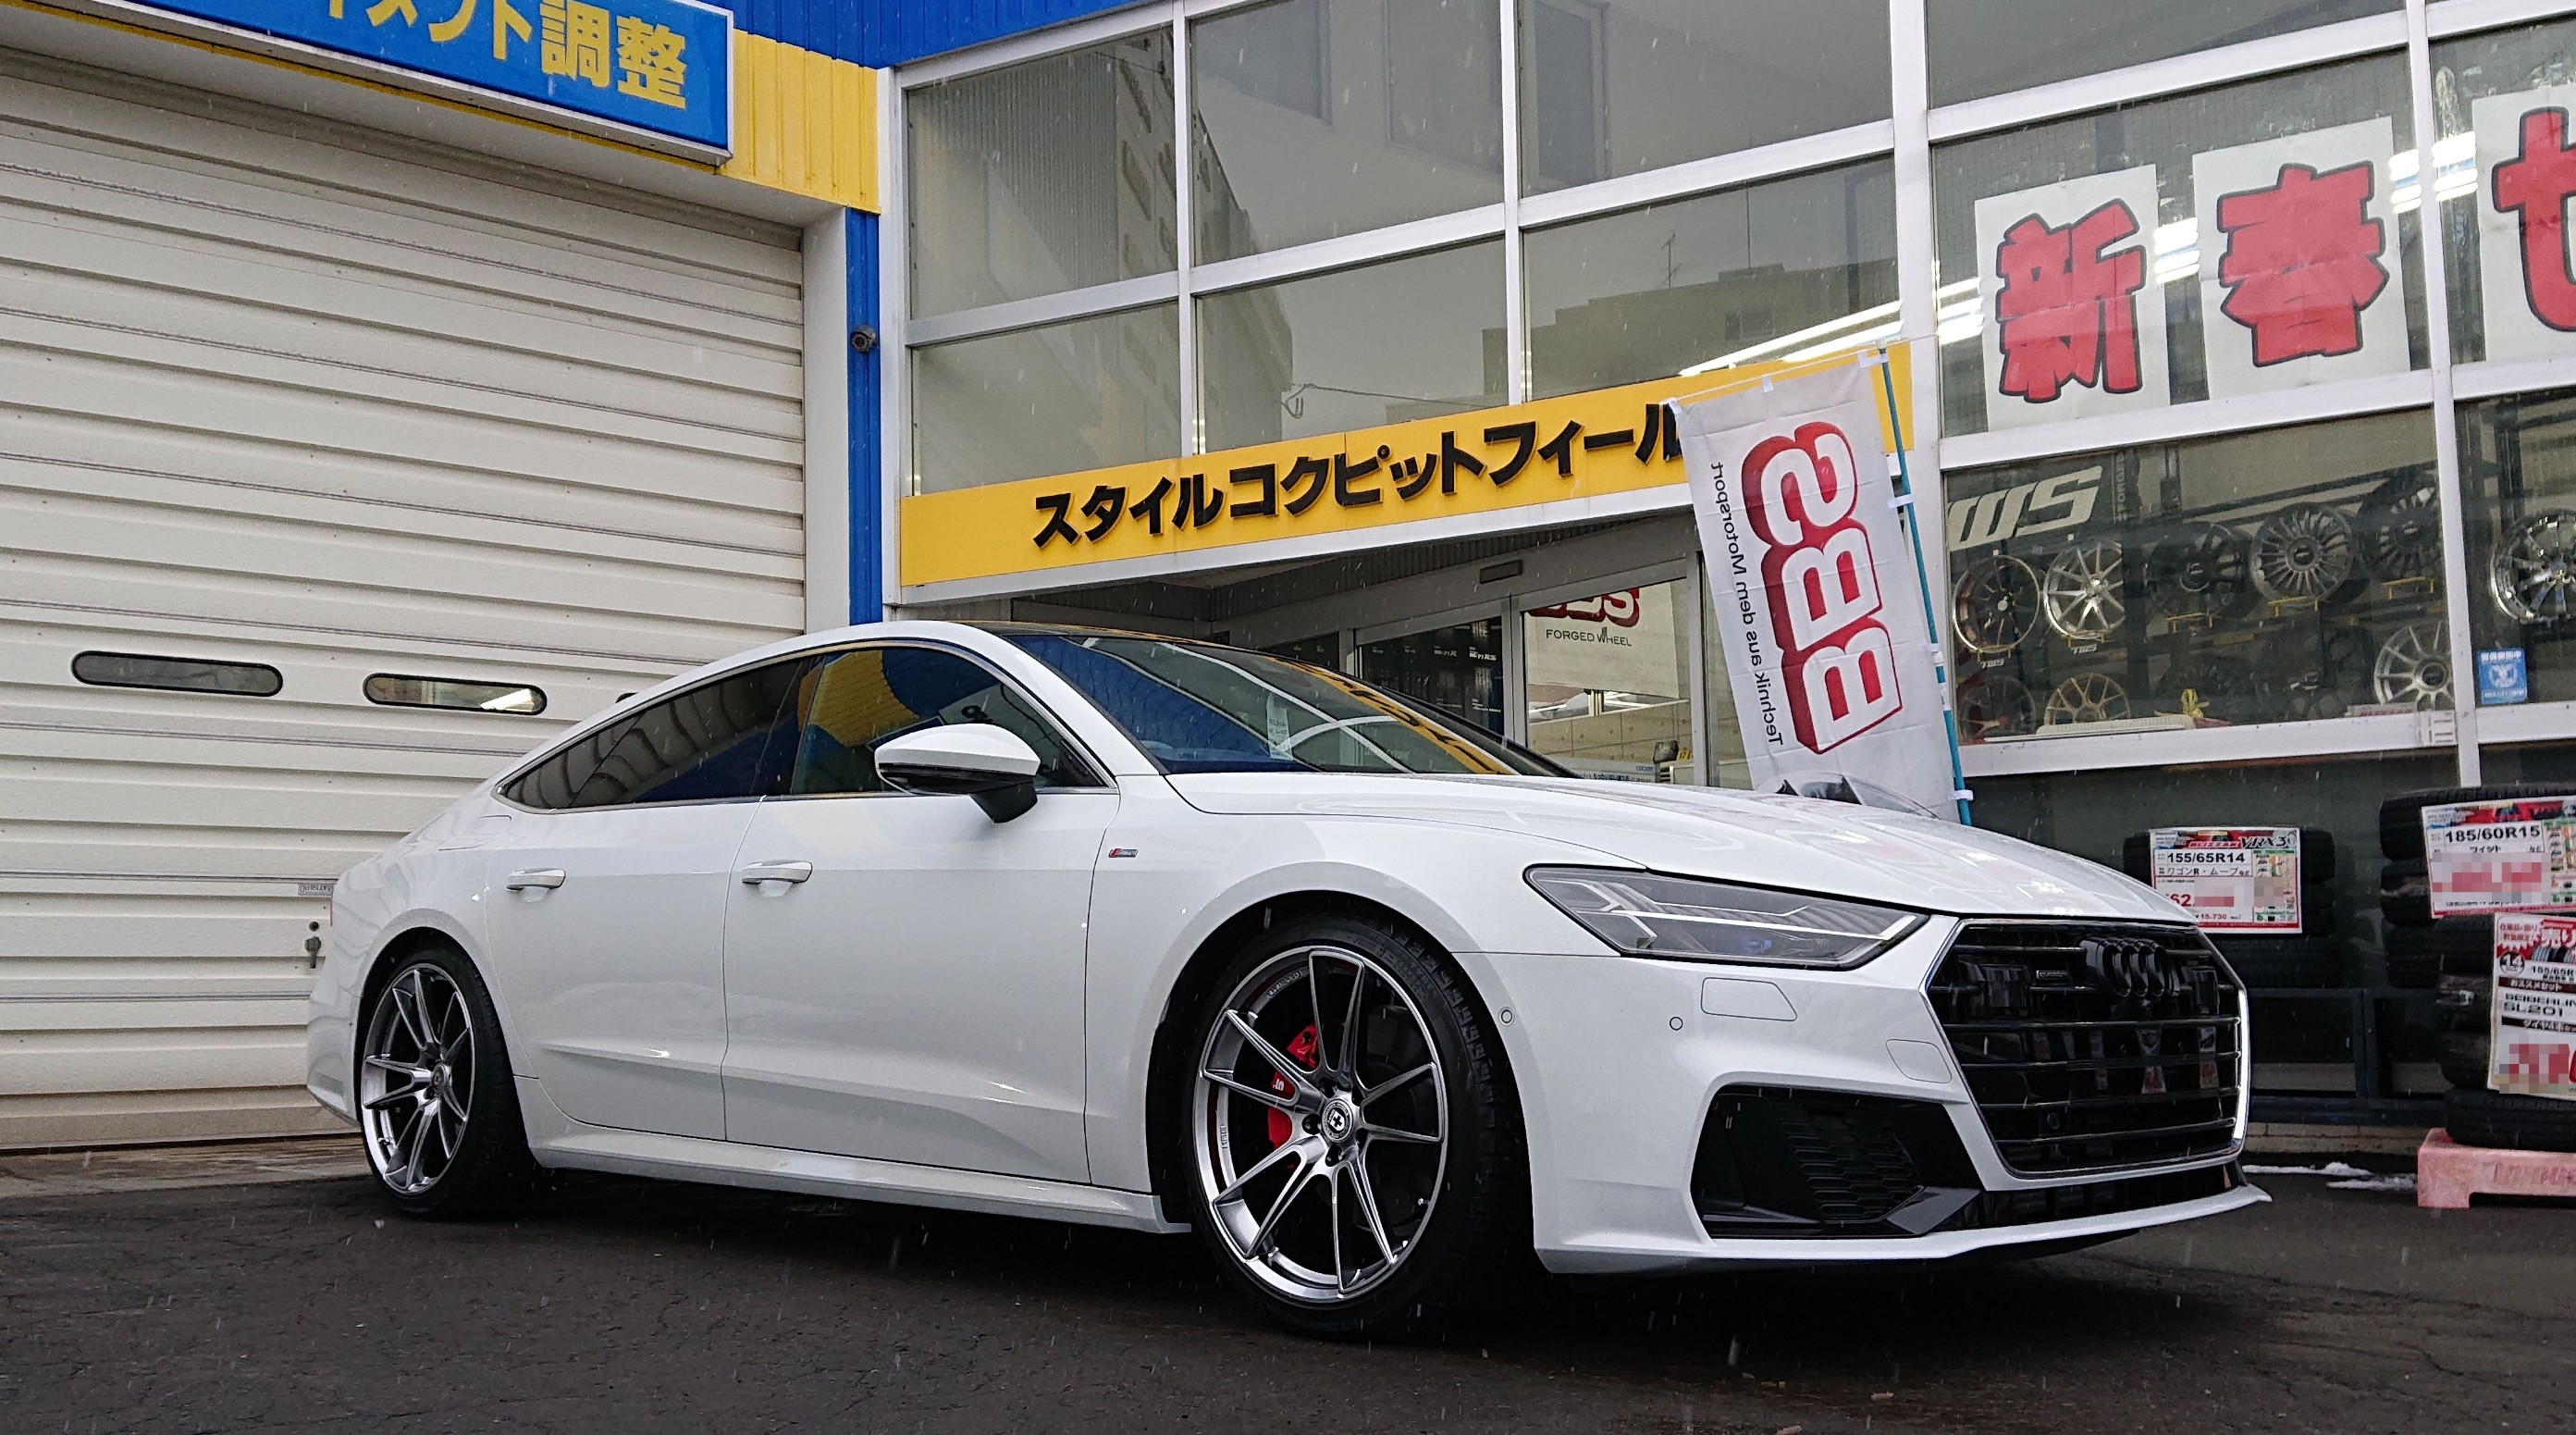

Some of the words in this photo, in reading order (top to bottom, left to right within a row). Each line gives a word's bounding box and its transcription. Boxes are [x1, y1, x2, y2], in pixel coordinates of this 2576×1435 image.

[328, 0, 686, 109] ント調整
[1032, 403, 1683, 549] スタイルコクピットフィール
[1947, 465, 2102, 552] WS
[1546, 629, 1595, 642] FORGED
[1596, 633, 1633, 647] WHEEL
[2446, 824, 2541, 843] 185/60R15
[2167, 852, 2245, 863] 155/65R14
[2502, 954, 2523, 968] 14
